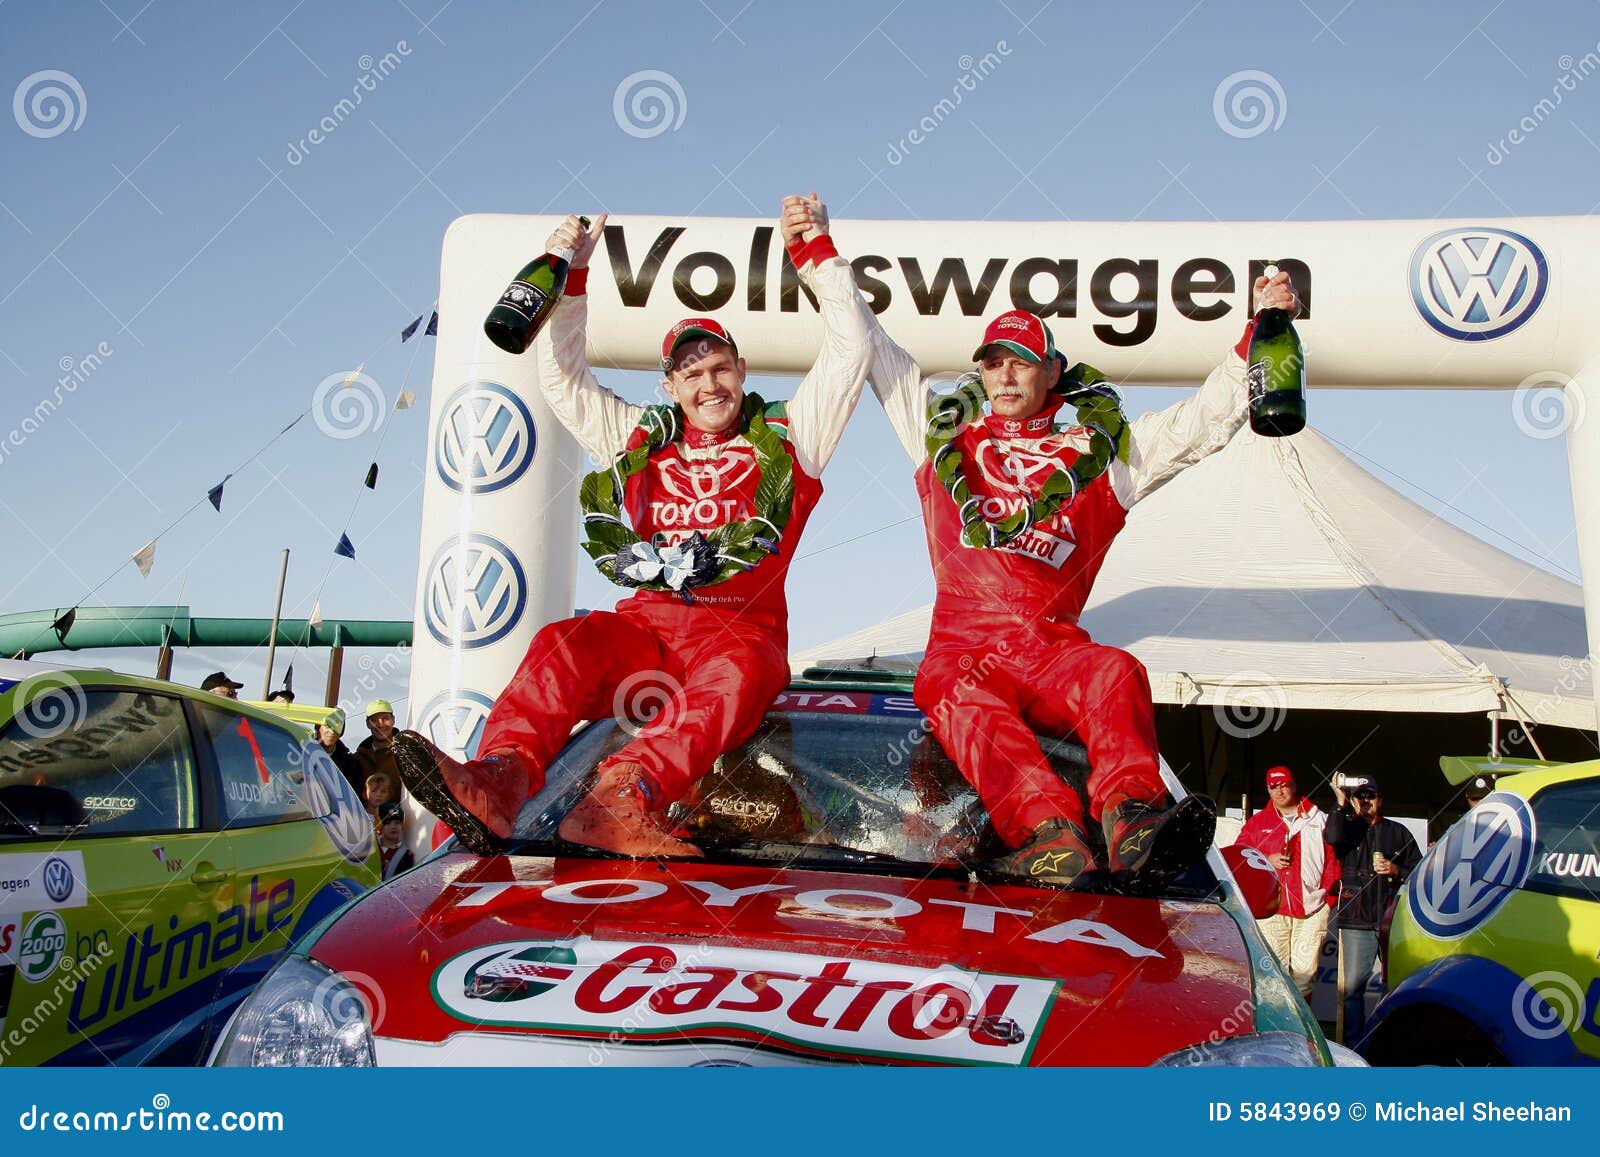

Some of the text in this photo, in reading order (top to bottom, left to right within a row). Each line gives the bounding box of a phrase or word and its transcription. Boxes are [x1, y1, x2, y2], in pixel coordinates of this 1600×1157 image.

[997, 323, 1029, 331] TOYOTA
[652, 500, 750, 526] TOYOTA
[236, 717, 269, 784] 1
[83, 796, 137, 812] sparco
[166, 859, 183, 873] NX
[0, 878, 30, 893] agen
[450, 877, 1163, 960] TOYOTA
[21, 934, 65, 953] 2000
[67, 874, 295, 1034] ultimate
[574, 945, 1018, 1048] Castrol
